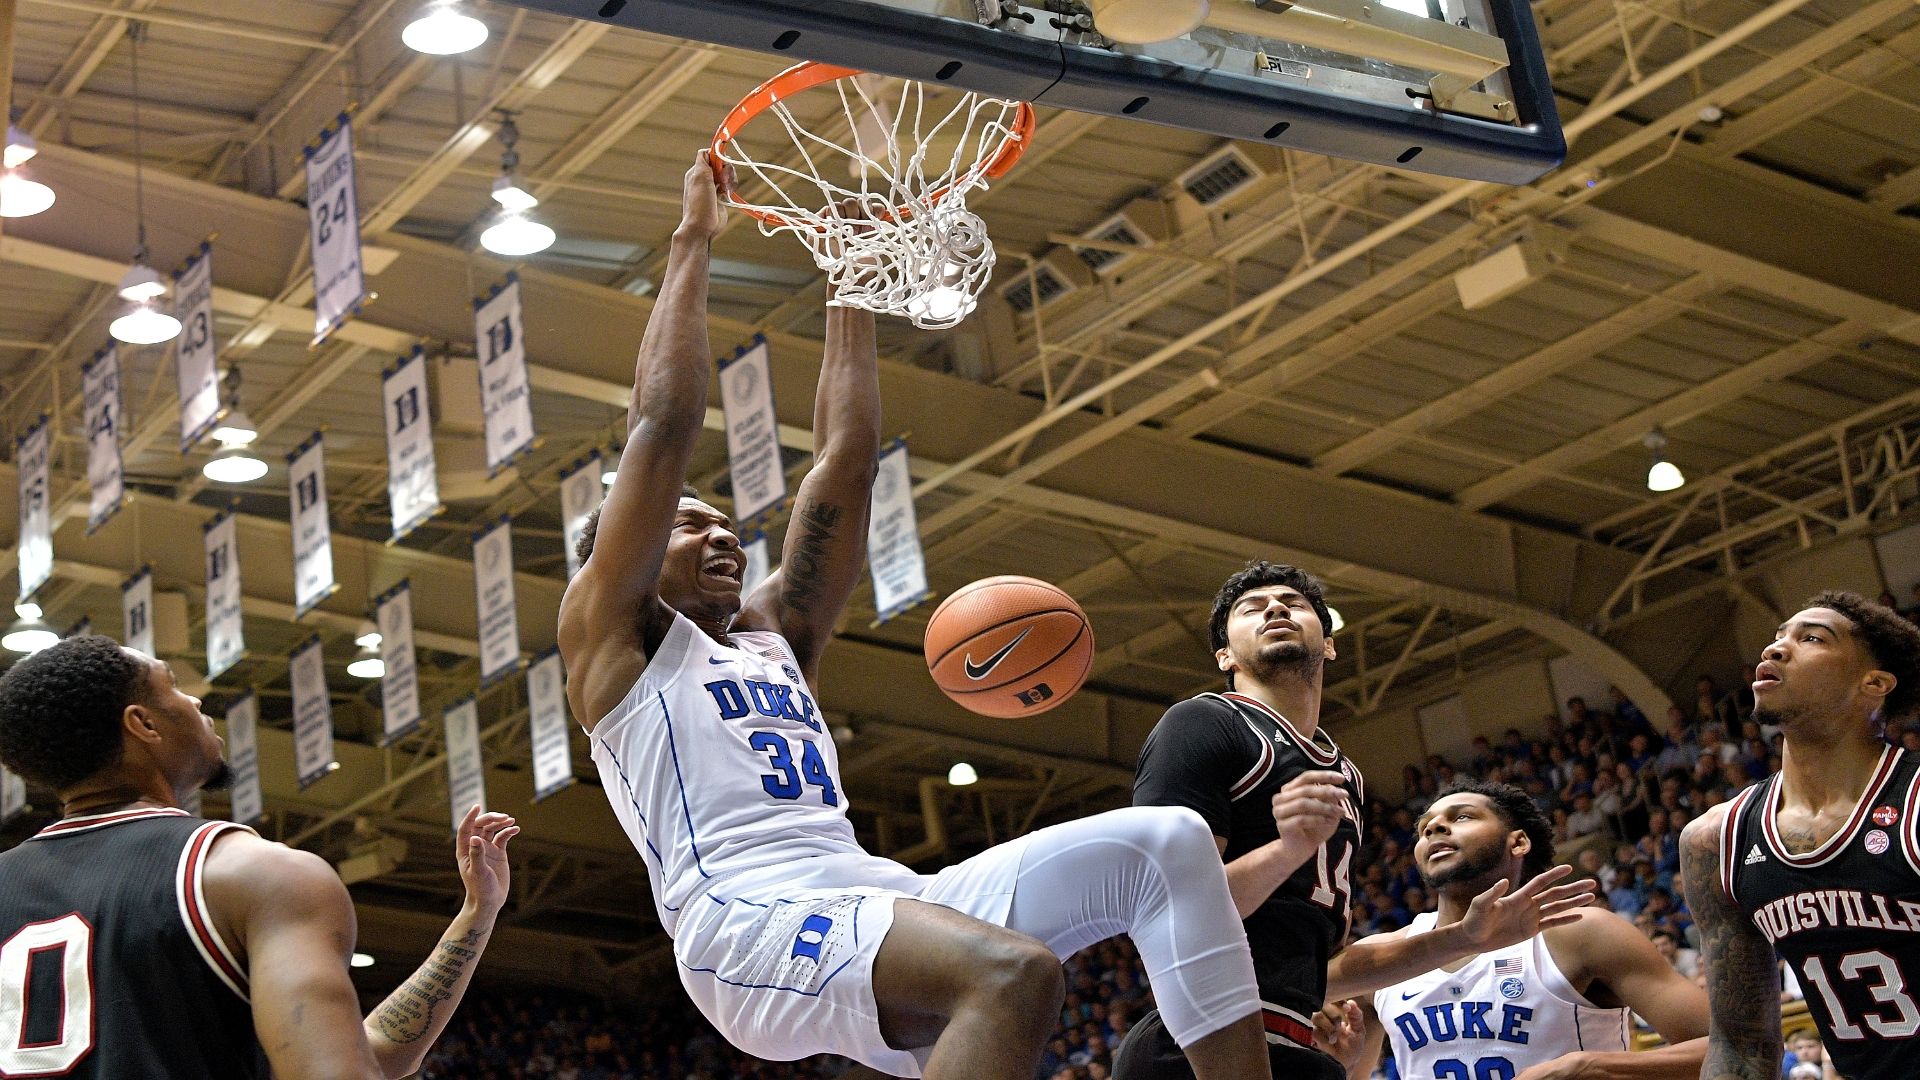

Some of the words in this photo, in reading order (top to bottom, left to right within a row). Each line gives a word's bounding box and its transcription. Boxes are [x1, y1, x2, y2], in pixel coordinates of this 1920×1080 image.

[1262, 61, 1283, 73] PI
[316, 188, 348, 246] 24
[704, 679, 822, 734] DUKE
[748, 731, 838, 808] 34
[1872, 811, 1898, 819] FAMILY
[1744, 855, 1767, 866] adidas
[1752, 889, 1920, 945] OUISVILLE
[0, 911, 96, 1080] 0
[1802, 949, 1920, 1040] 13
[1394, 1002, 1533, 1051] DUKE
